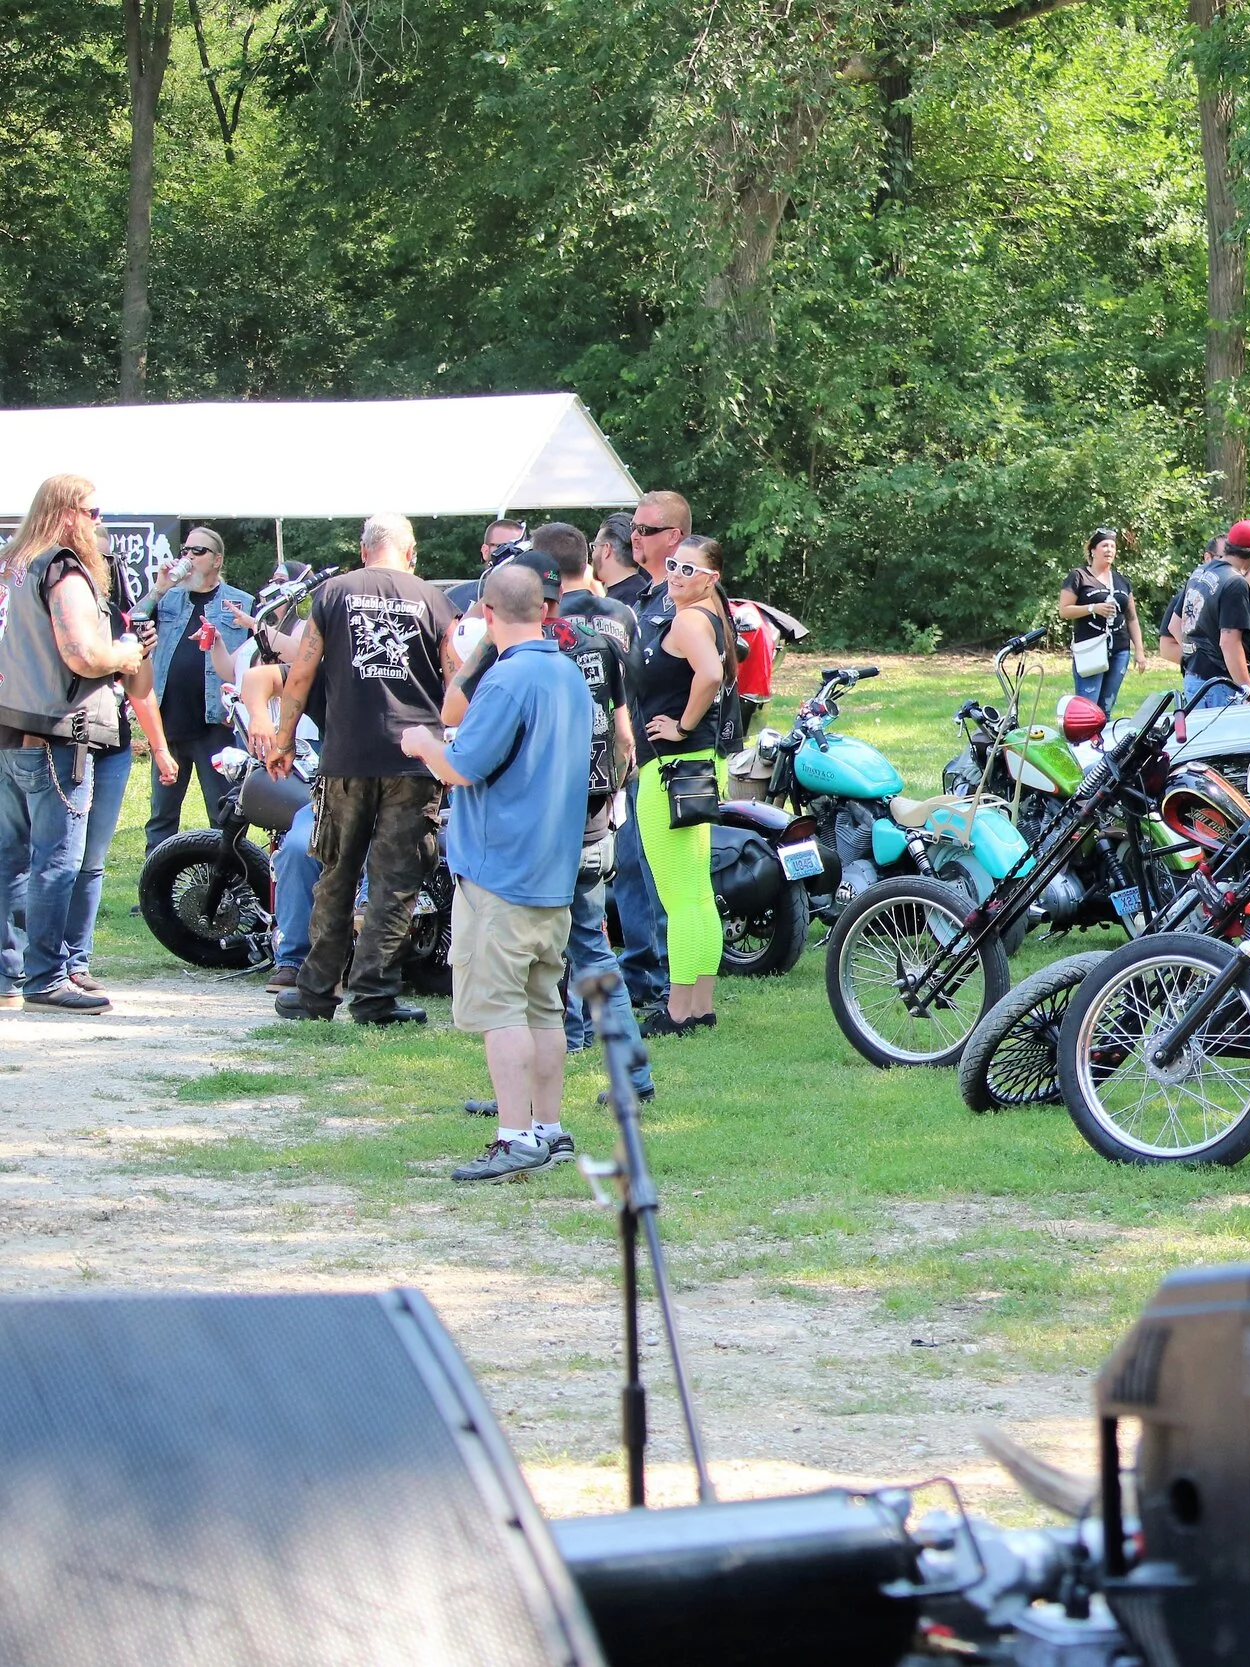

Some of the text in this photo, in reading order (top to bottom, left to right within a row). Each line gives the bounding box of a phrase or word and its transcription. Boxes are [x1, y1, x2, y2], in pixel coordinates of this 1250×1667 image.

[352, 596, 418, 613] Diablo Lobos
[366, 665, 402, 677] Nation
